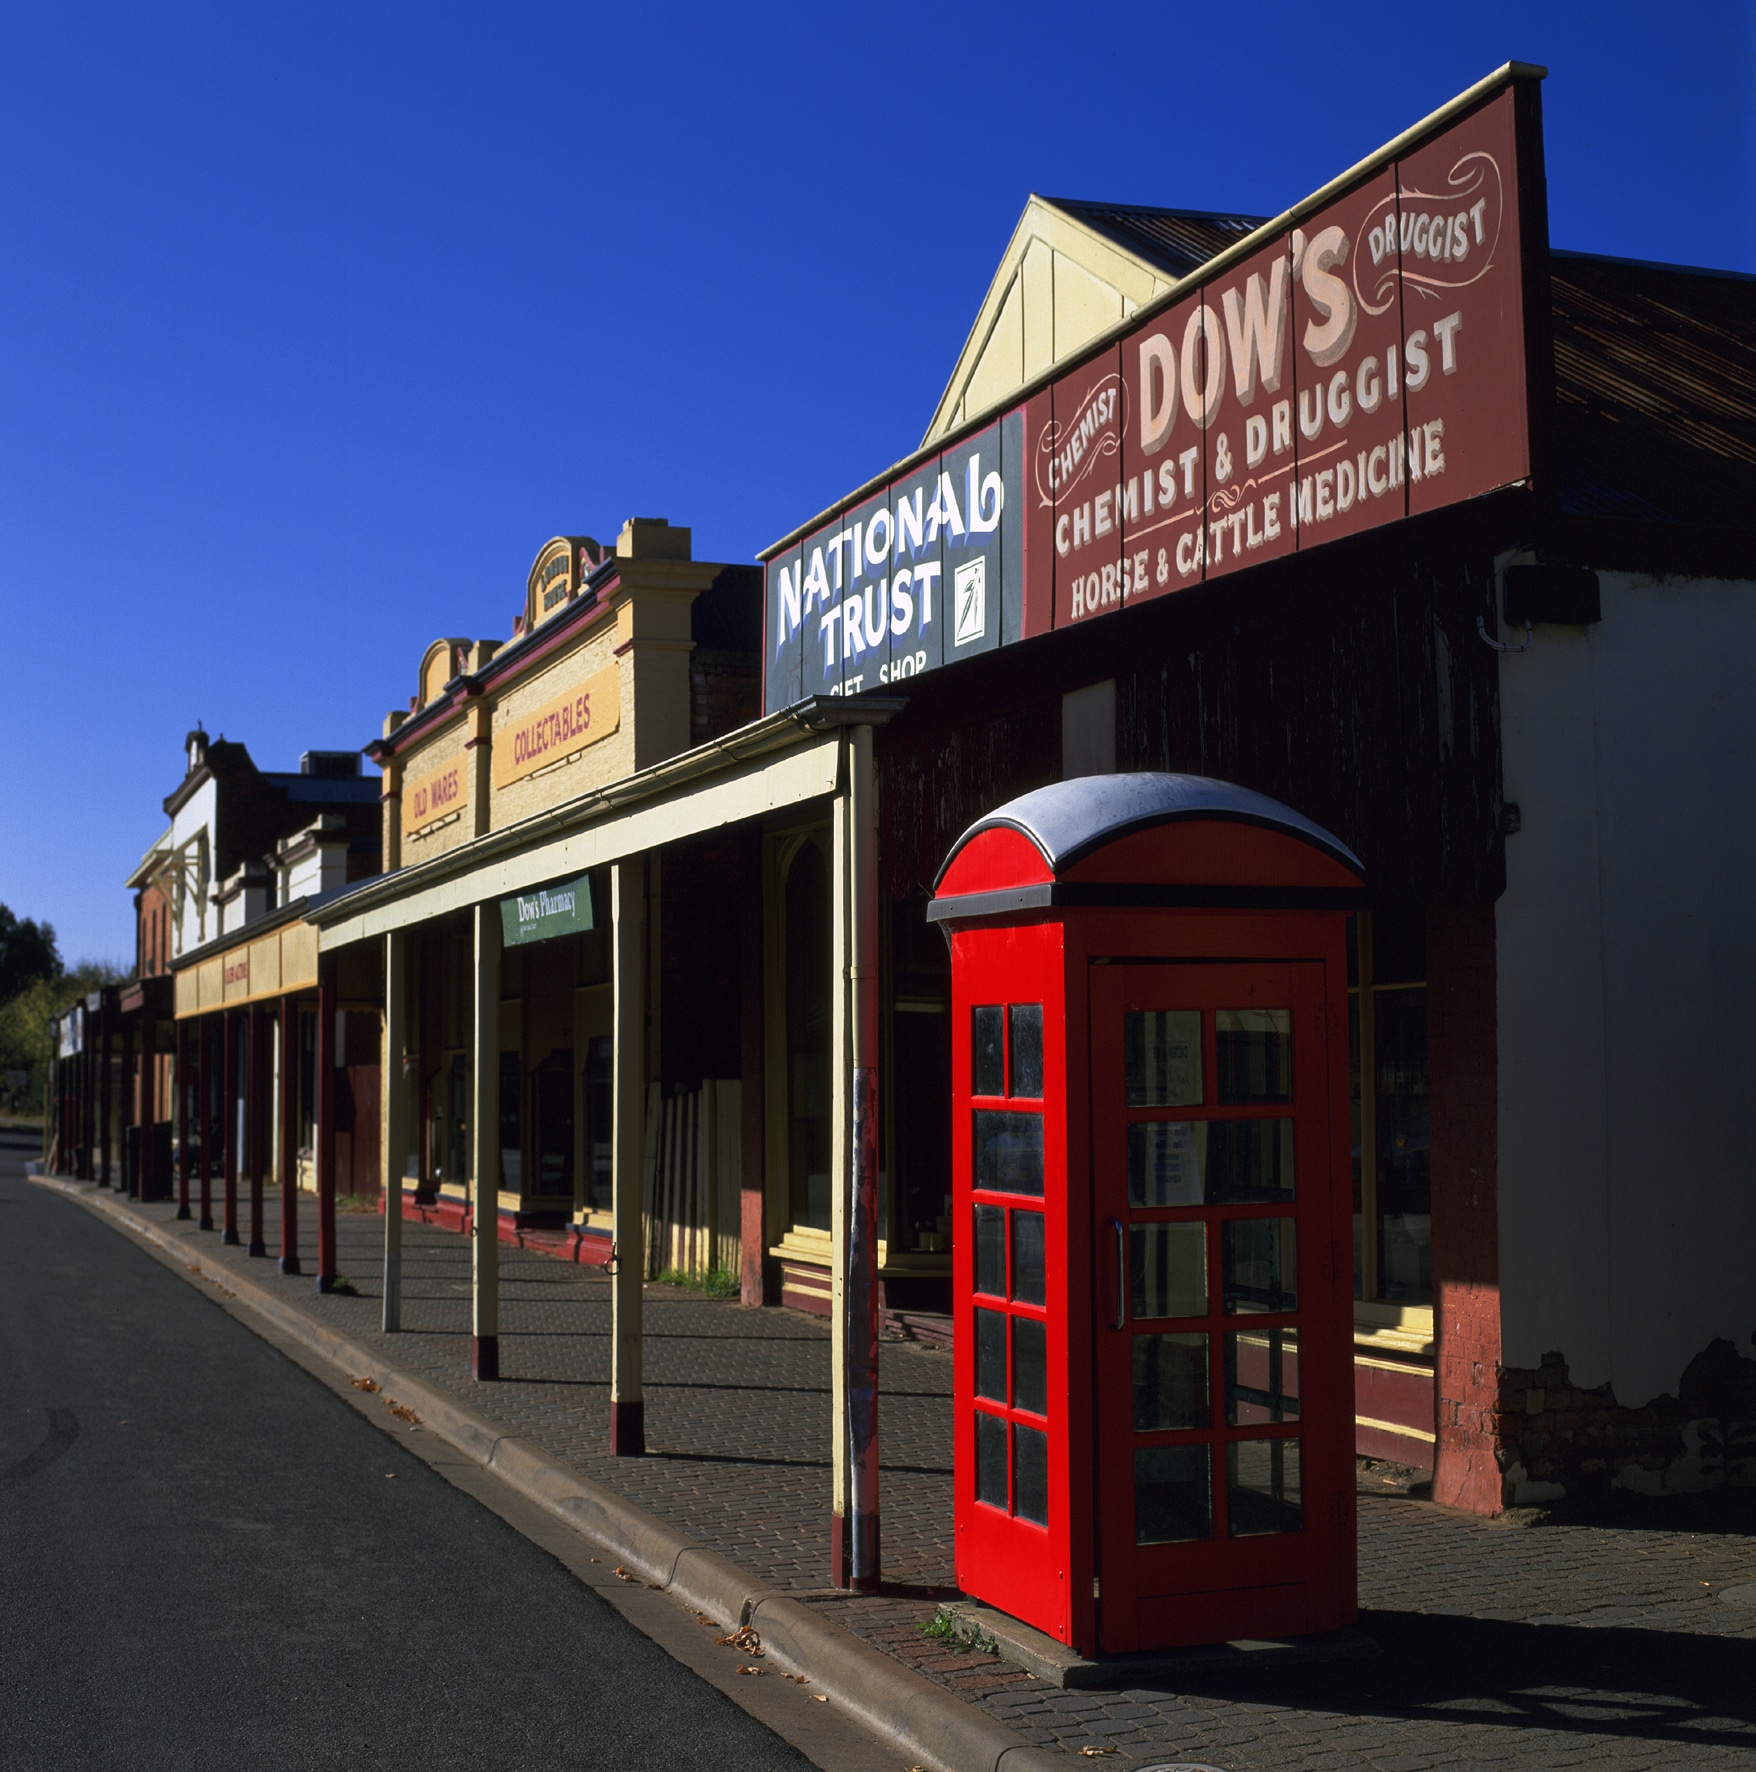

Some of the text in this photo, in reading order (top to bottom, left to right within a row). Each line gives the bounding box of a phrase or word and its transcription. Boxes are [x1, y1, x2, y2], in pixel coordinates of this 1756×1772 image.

[1368, 197, 1486, 267] DRUGGIST
[1138, 225, 1358, 456] DOW'S
[1048, 388, 1117, 491] CHEMIST
[1056, 310, 1463, 558] CHEMIST & DRUGGIST
[776, 453, 1005, 650] NATIONAL
[1071, 417, 1446, 620] HORSE & CATTLE MEDICINE
[819, 561, 942, 672] TRUST
[879, 650, 927, 684] SHOP
[514, 693, 591, 765] COLLECTABLES
[413, 769, 458, 818] OLD WARES
[516, 890, 576, 922] Dow's Pharmacy
